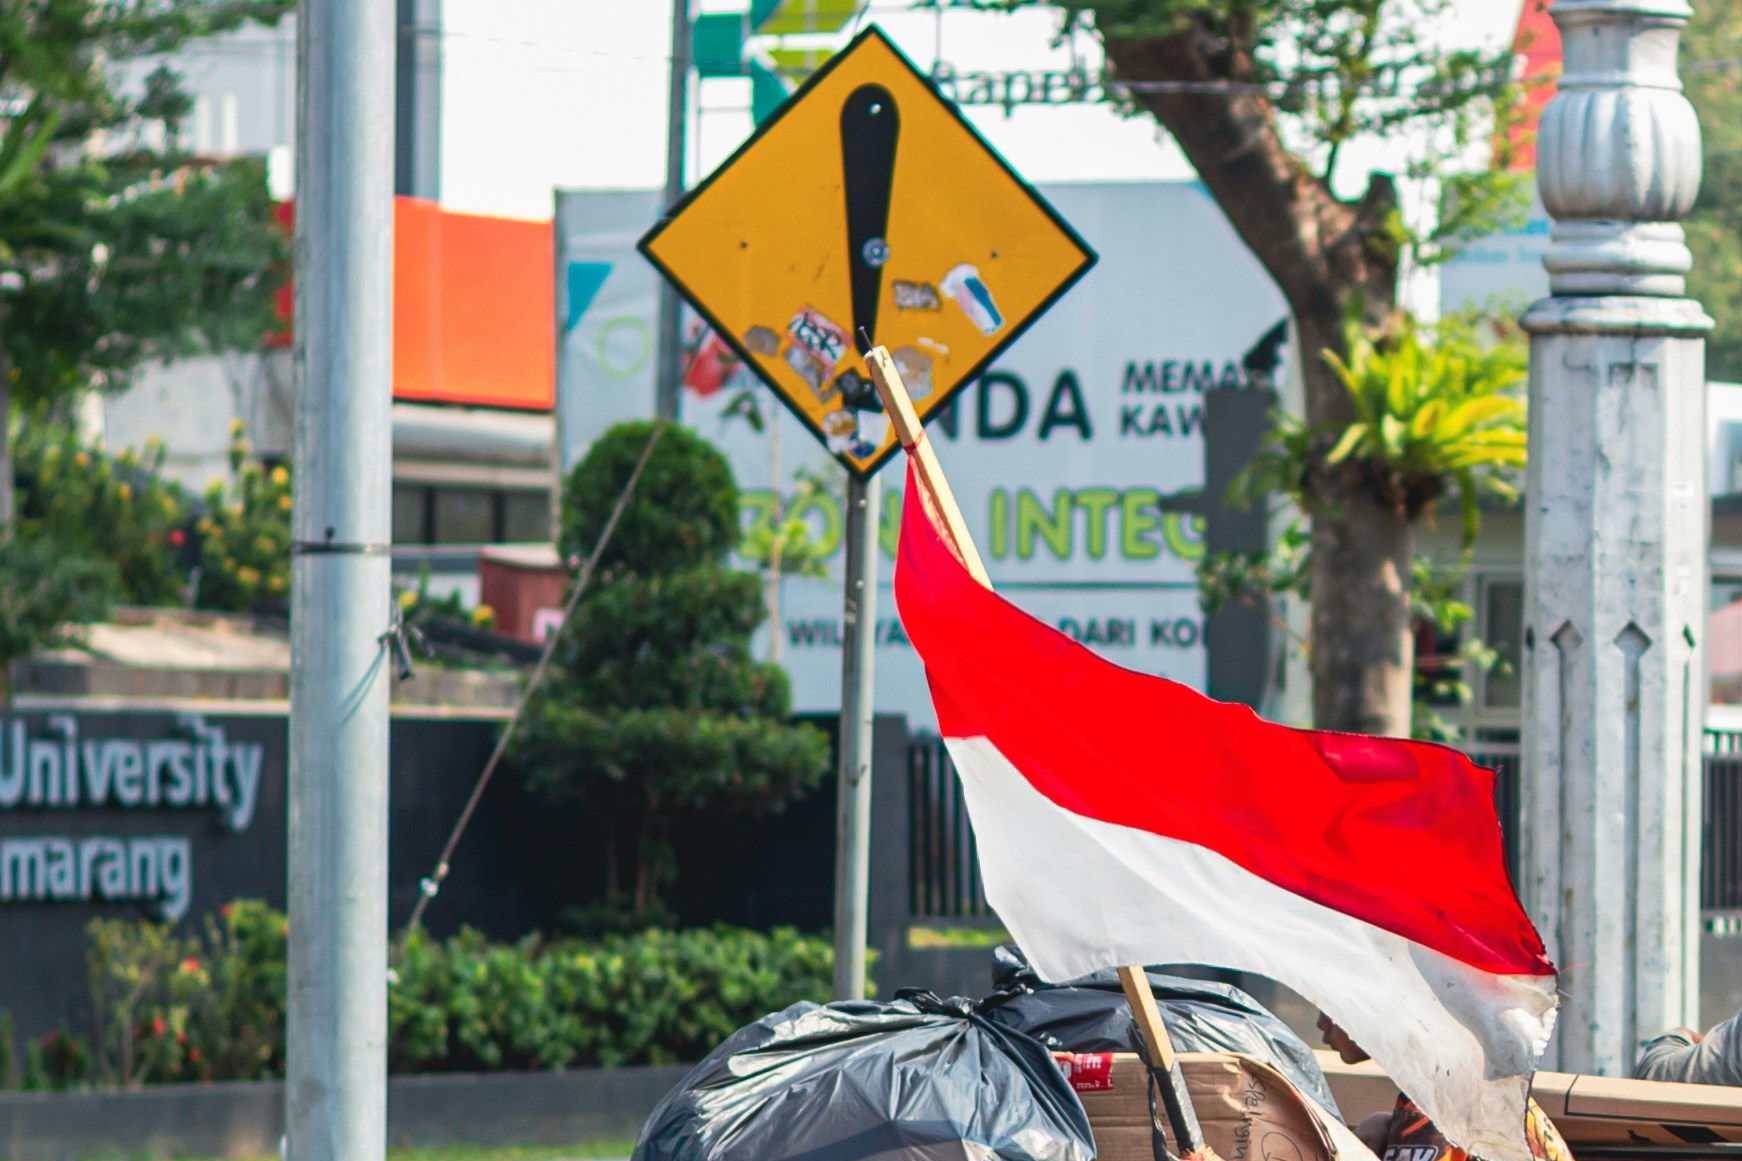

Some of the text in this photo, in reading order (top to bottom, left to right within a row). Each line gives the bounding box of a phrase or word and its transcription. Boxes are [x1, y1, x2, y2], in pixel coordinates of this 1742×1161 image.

[1121, 359, 1246, 394] MEMA
[1120, 403, 1204, 438] KAW
[988, 486, 1207, 562] INTEG
[1150, 616, 1208, 649] KO
[0, 714, 263, 831] University
[0, 835, 192, 921] marang
